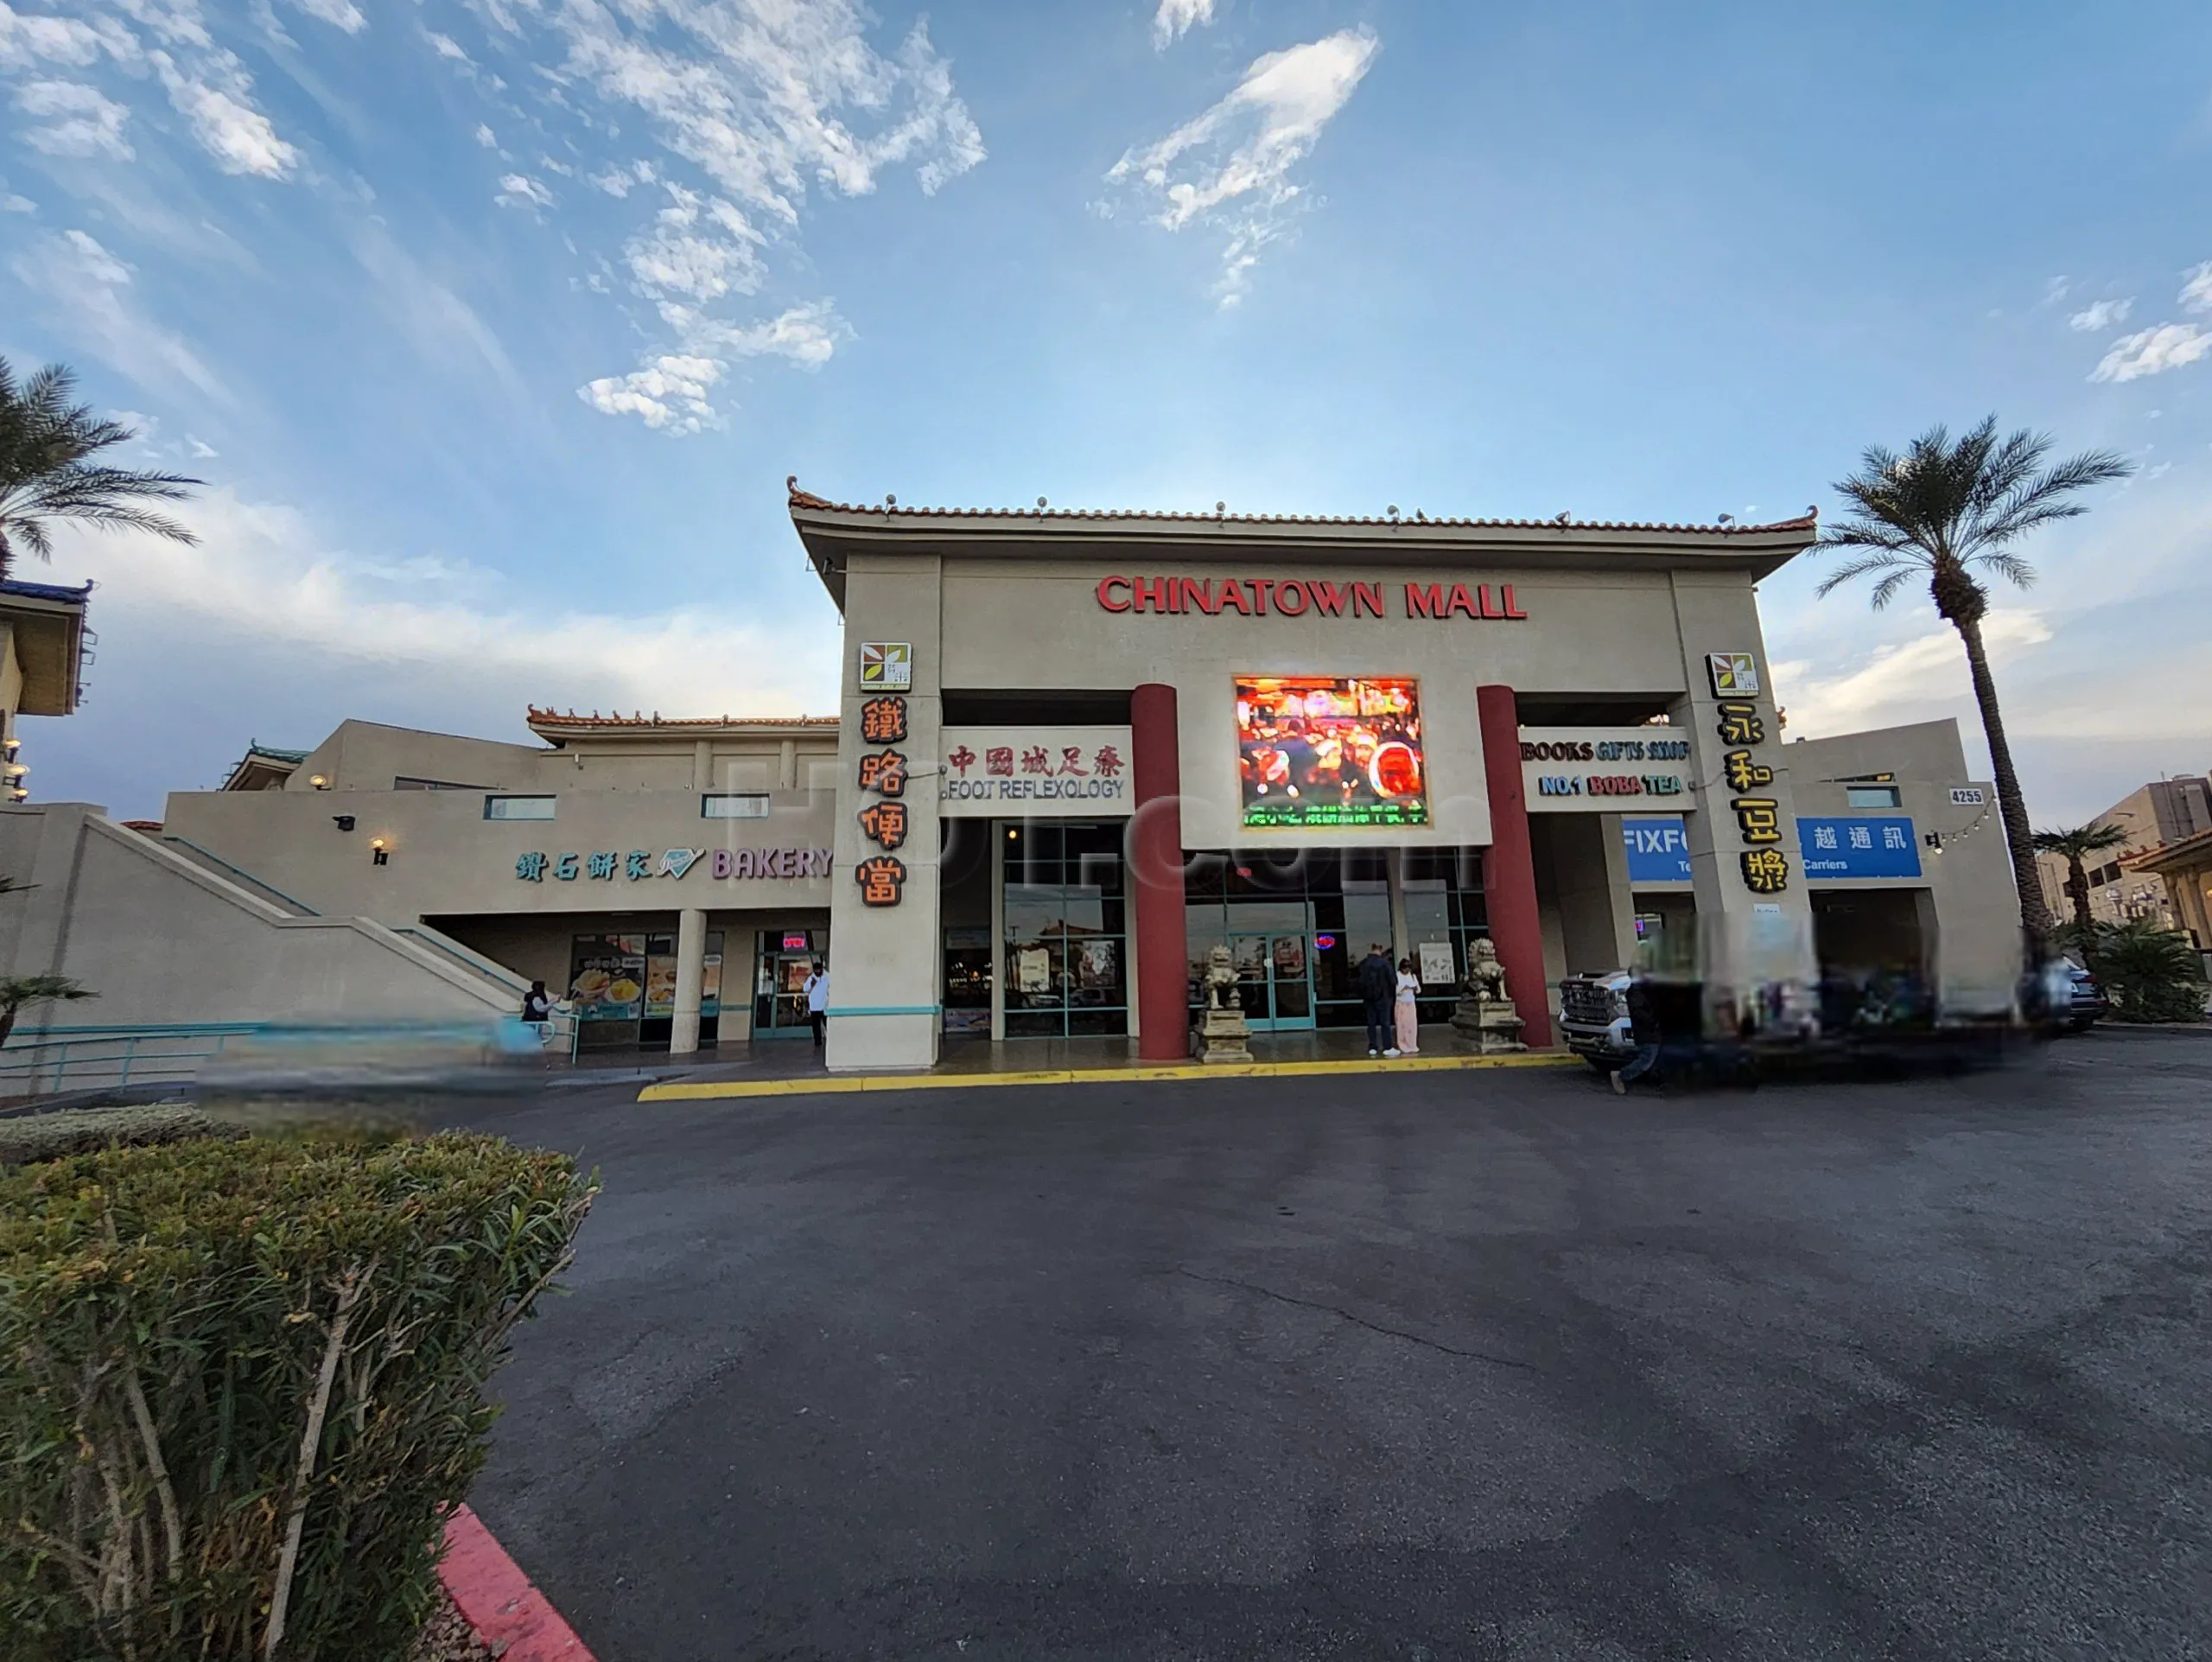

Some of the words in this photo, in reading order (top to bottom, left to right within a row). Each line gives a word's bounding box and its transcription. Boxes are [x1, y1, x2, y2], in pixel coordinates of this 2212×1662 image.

[1096, 576, 1386, 618] CHINATOWN
[1406, 583, 1529, 621] MALL
[1519, 742, 1593, 761] BOOKS
[949, 780, 995, 799] FOOT
[999, 780, 1124, 799] REFLEXOLOGY
[1586, 776, 1643, 796] BOBA
[1643, 775, 1683, 795] TEA
[1953, 791, 1982, 802] 4255
[857, 697, 907, 906] 鐵路便當
[1719, 704, 1789, 894] 永和豆漿
[1624, 829, 1688, 853] FIXF
[712, 848, 833, 880] BAKERY
[1802, 859, 1847, 869] Carriers
